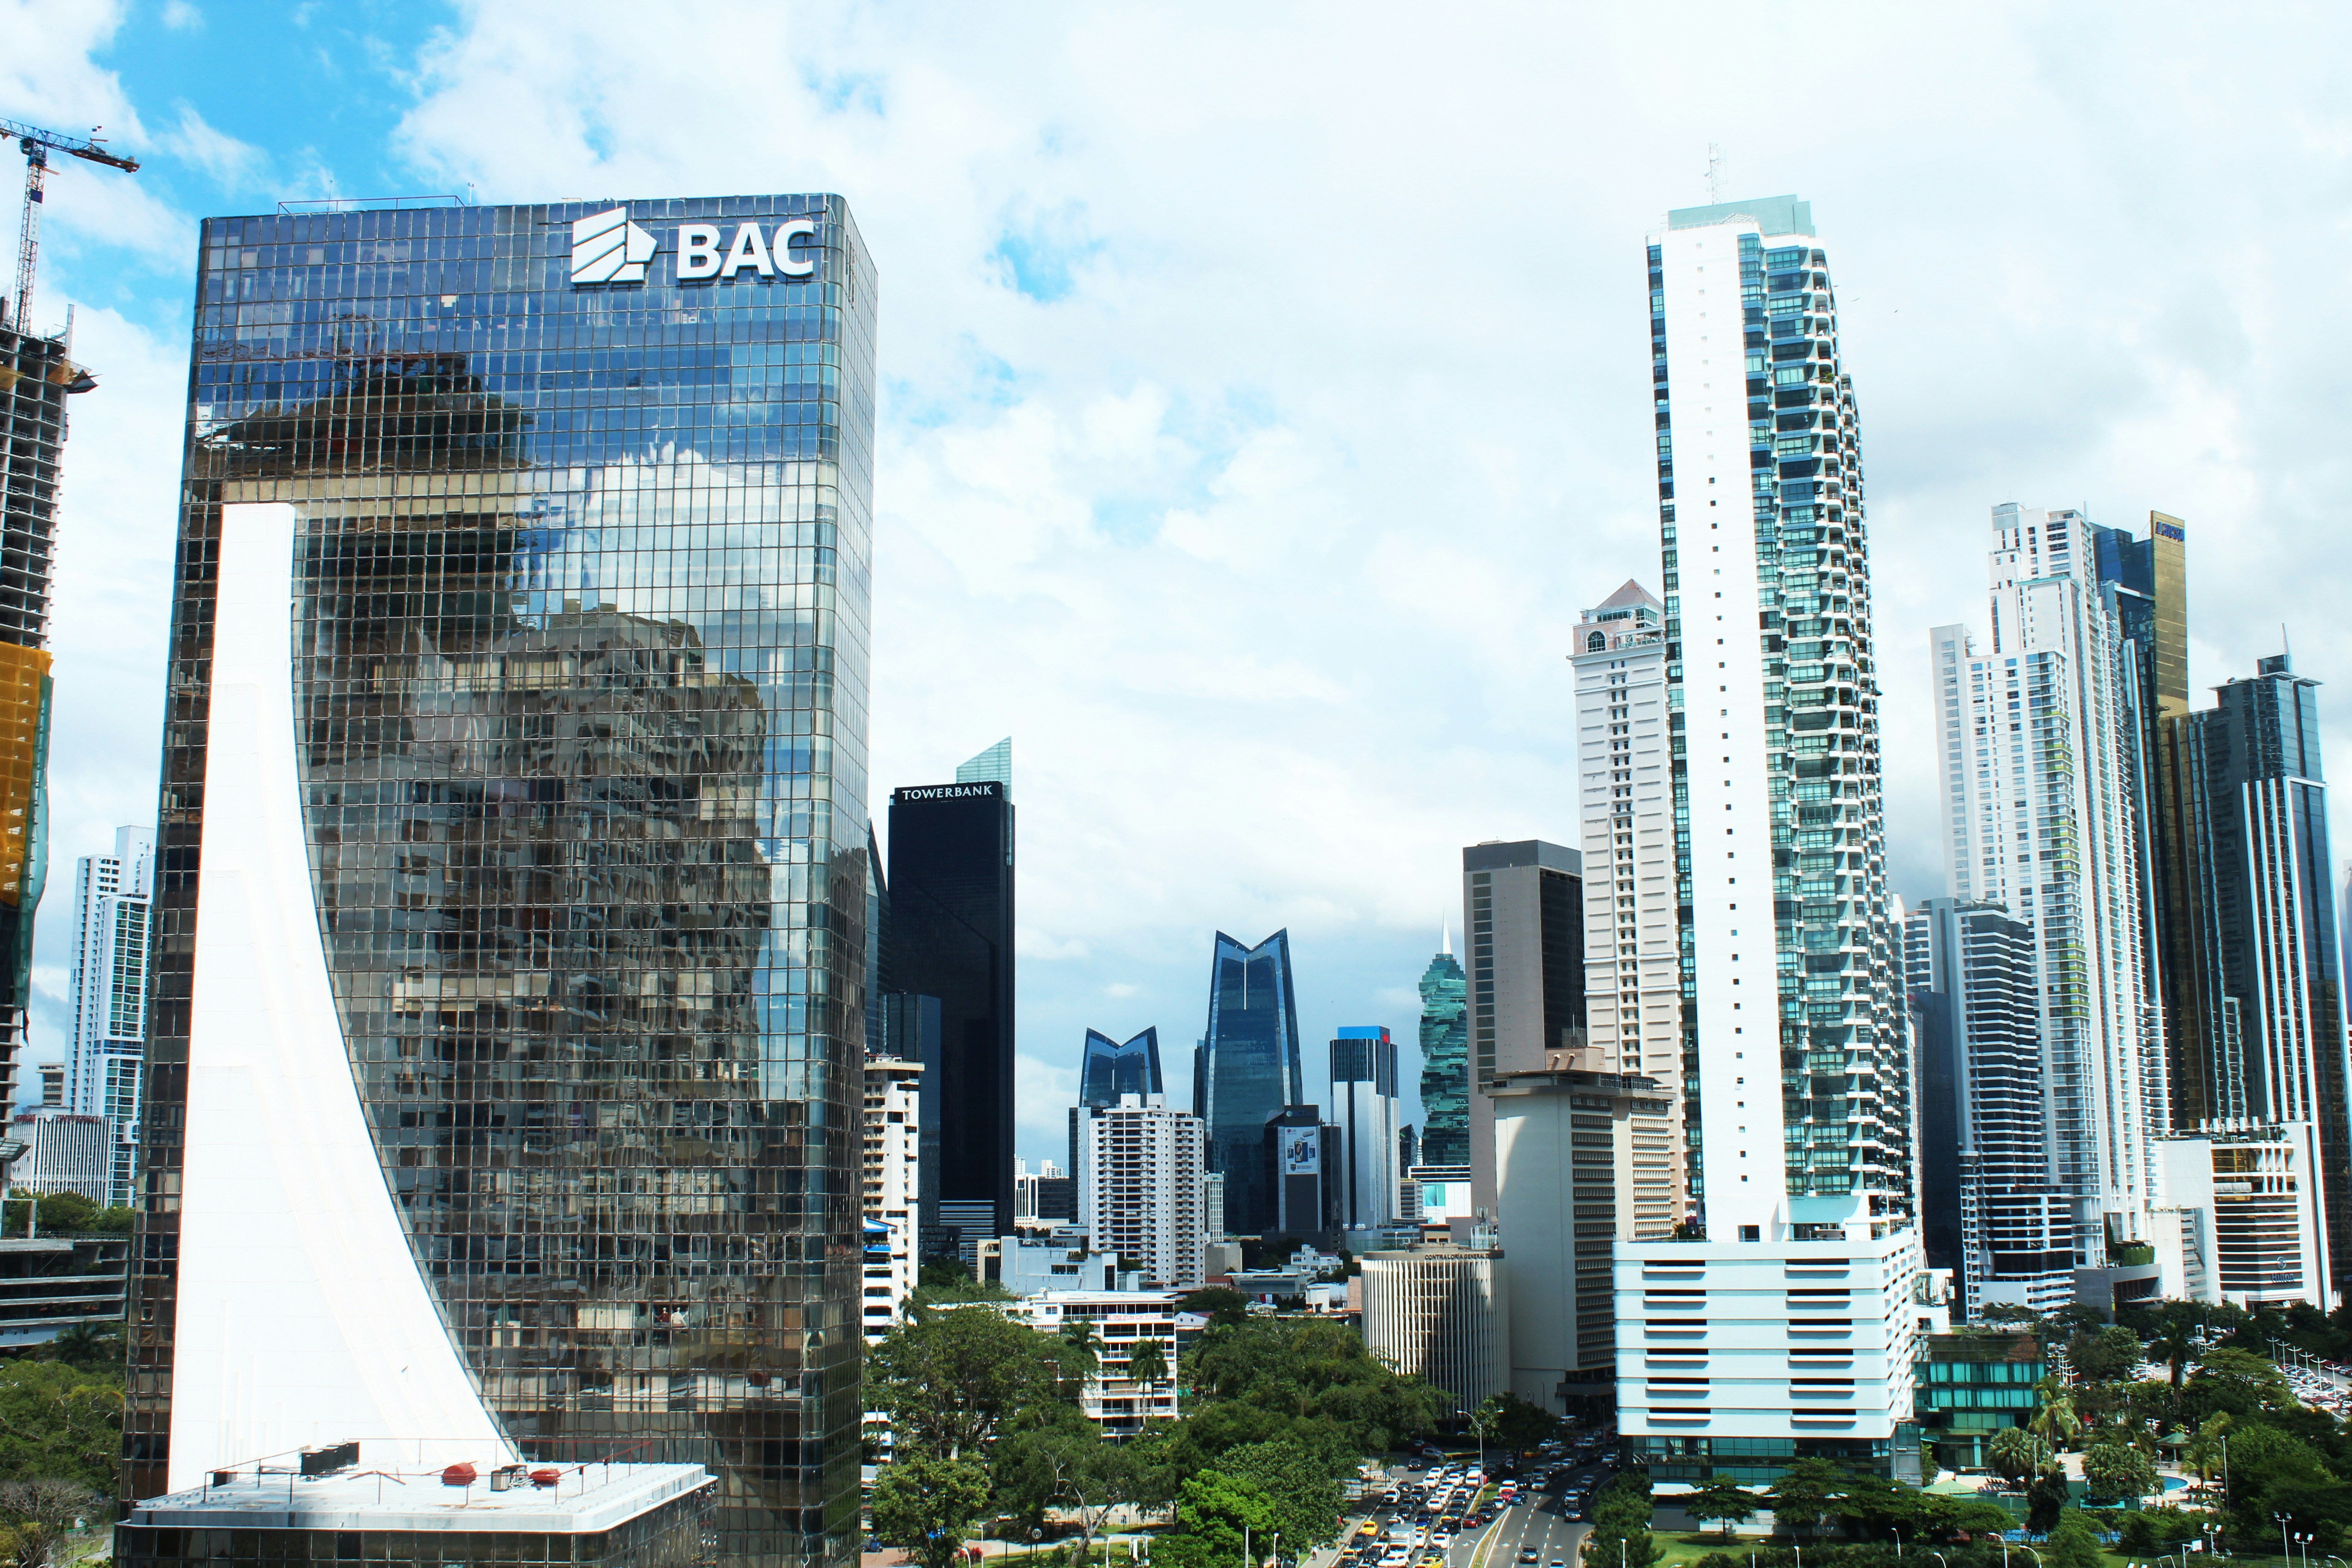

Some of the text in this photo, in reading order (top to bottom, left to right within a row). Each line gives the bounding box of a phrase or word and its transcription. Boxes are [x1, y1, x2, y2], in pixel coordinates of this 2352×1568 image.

[677, 220, 814, 280] BAC
[902, 785, 993, 800] TOWERBANK
[2271, 1273, 2294, 1281] Hilton
